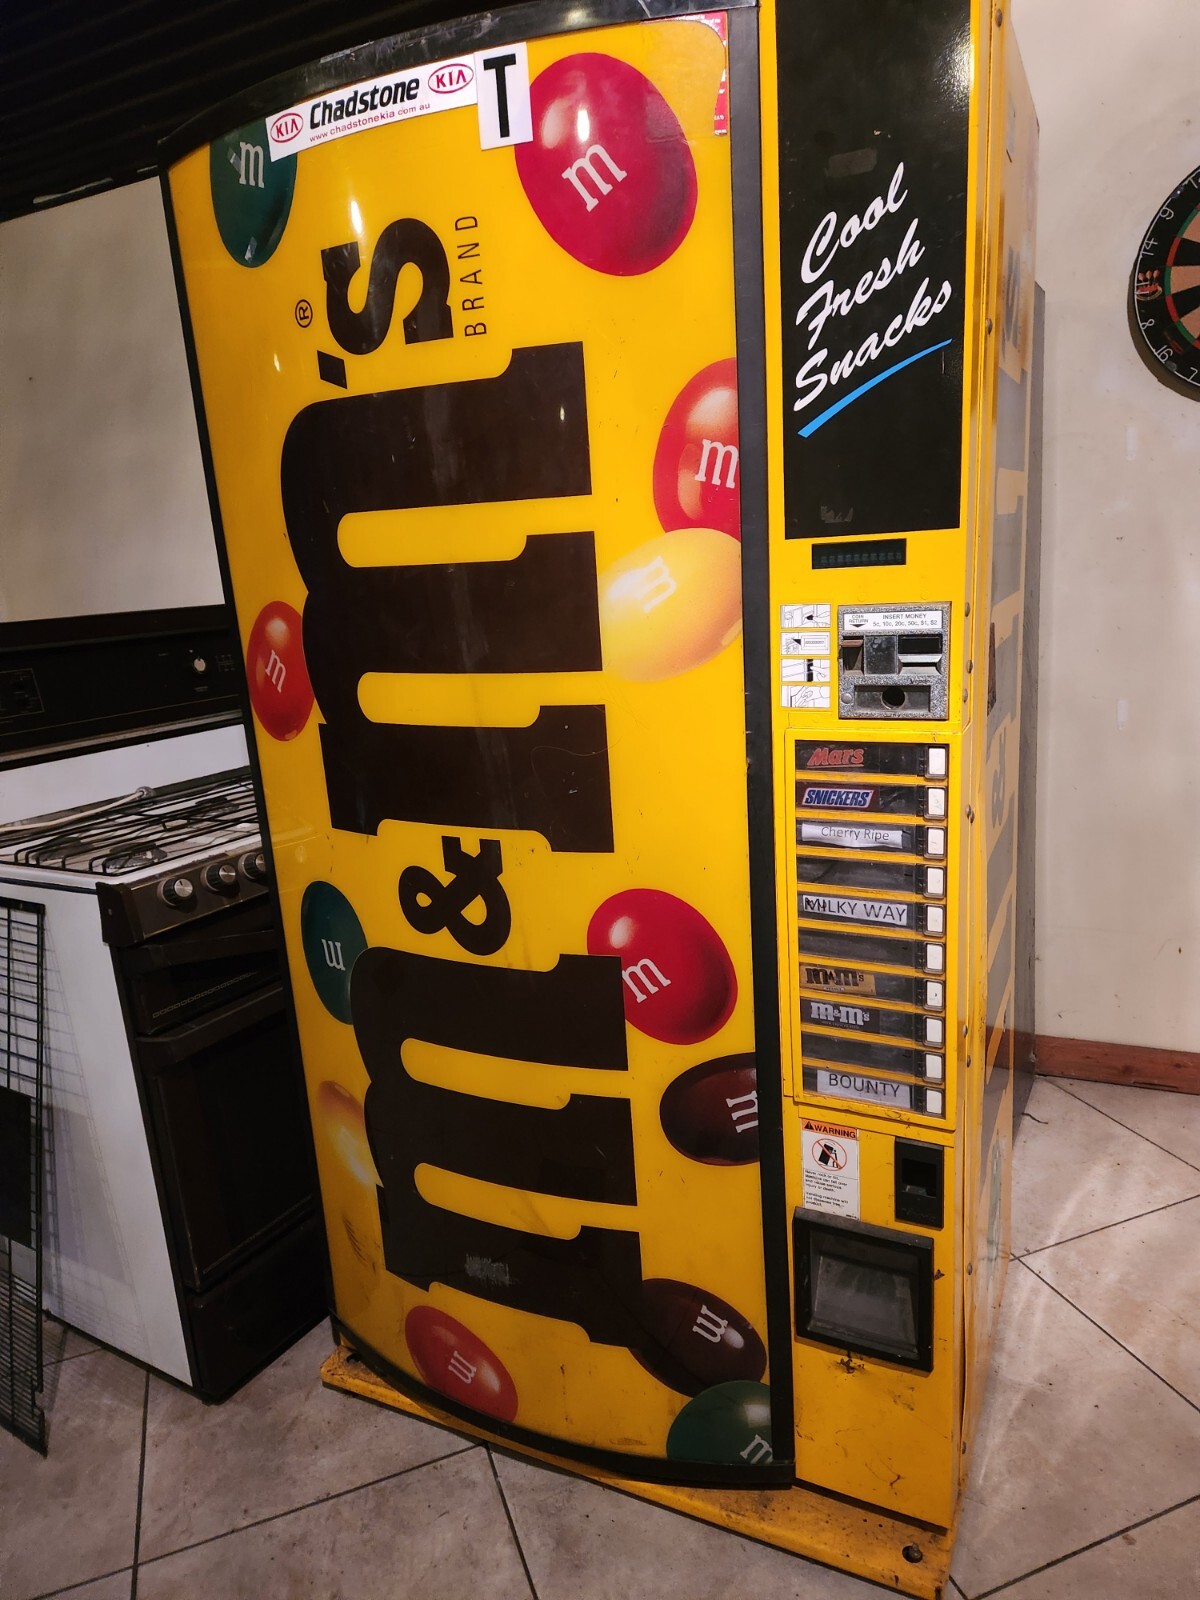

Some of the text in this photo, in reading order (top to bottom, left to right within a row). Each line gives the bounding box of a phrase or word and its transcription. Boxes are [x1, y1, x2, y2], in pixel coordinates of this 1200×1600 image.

[434, 68, 467, 89] KIA
[483, 53, 517, 138] T
[309, 77, 420, 130] Chadstone
[239, 141, 265, 189] m
[561, 142, 628, 213] m
[801, 161, 909, 284] Cool
[455, 215, 487, 337] BRAND
[795, 217, 926, 351] Fresh
[793, 277, 952, 412] Snacks
[694, 438, 739, 489] m
[265, 649, 287, 694] m
[806, 747, 865, 767] Mars
[804, 788, 871, 807] SNICKERS
[821, 826, 890, 842] Cherry Ripe
[804, 897, 906, 922] MILKY WAY
[621, 958, 672, 1004] m
[828, 1073, 901, 1098] BOUNTY
[814, 1124, 857, 1139] WARNING
